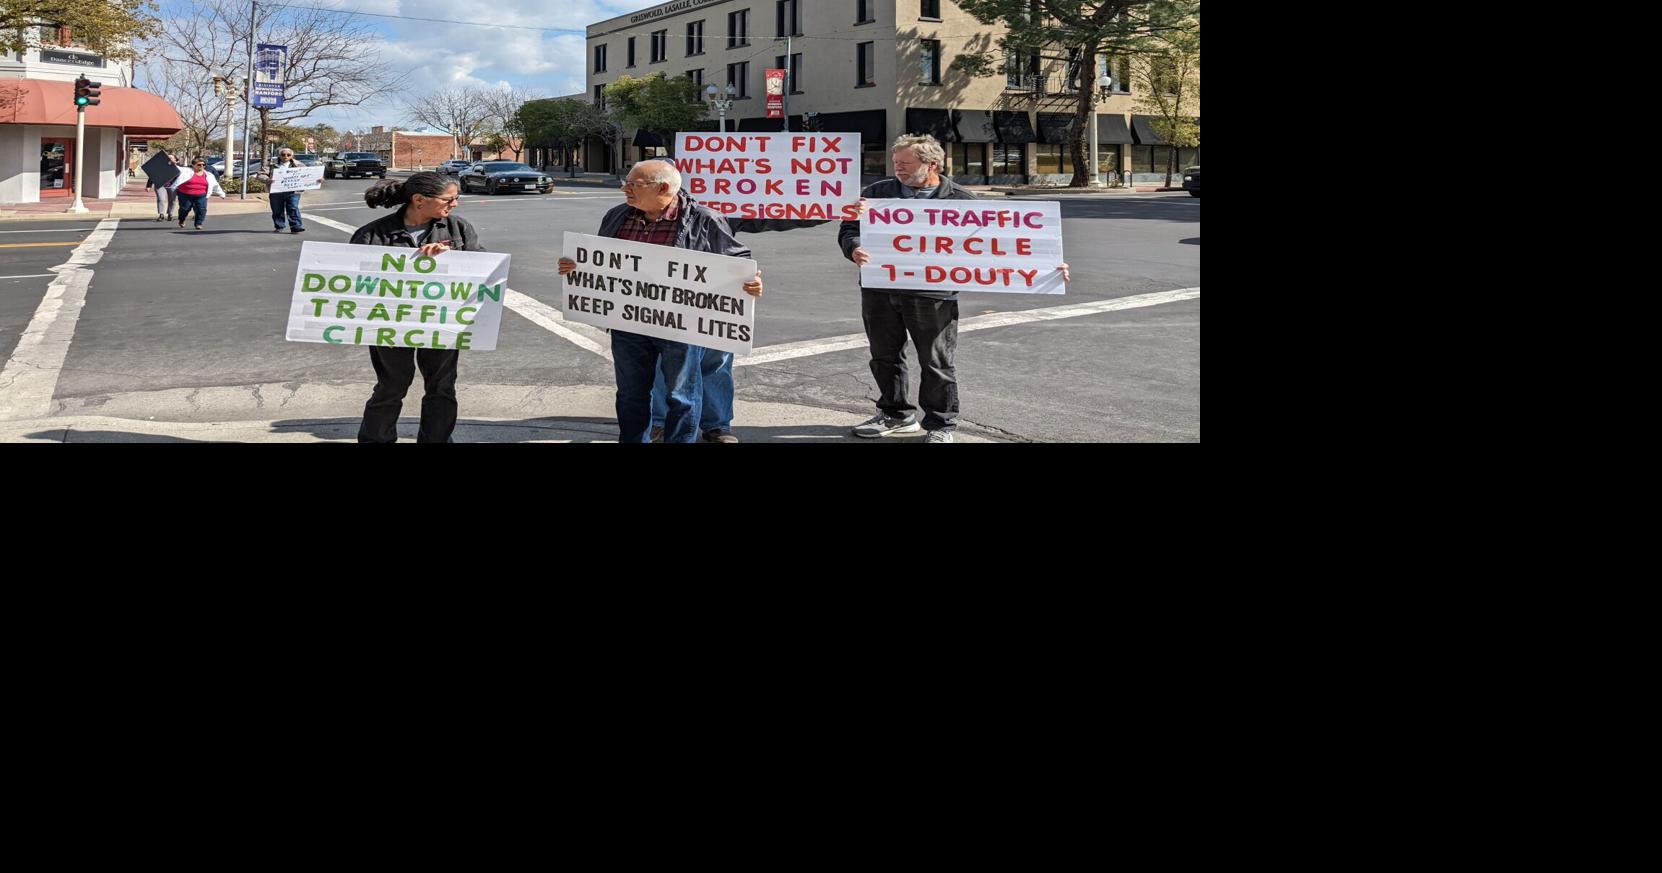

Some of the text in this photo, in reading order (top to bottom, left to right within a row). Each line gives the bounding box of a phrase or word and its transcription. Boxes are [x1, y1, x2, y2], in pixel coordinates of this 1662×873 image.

[685, 135, 842, 153] DON'T FIX
[675, 157, 853, 174] WHAT'S NOT
[690, 178, 842, 196] BROKEN
[869, 208, 1044, 229] NO TRAFFIC
[893, 235, 1032, 256] CIRCLE
[381, 253, 437, 274] NO
[576, 247, 708, 284] DON'T FIX
[301, 273, 501, 302] DOWNTOWN
[567, 270, 744, 316] WHAT'S NOT BROKEN
[310, 298, 477, 325] TRAFFIC
[568, 294, 751, 342] KEEP SIGNAL LITES
[322, 325, 473, 350] CIRCLE
